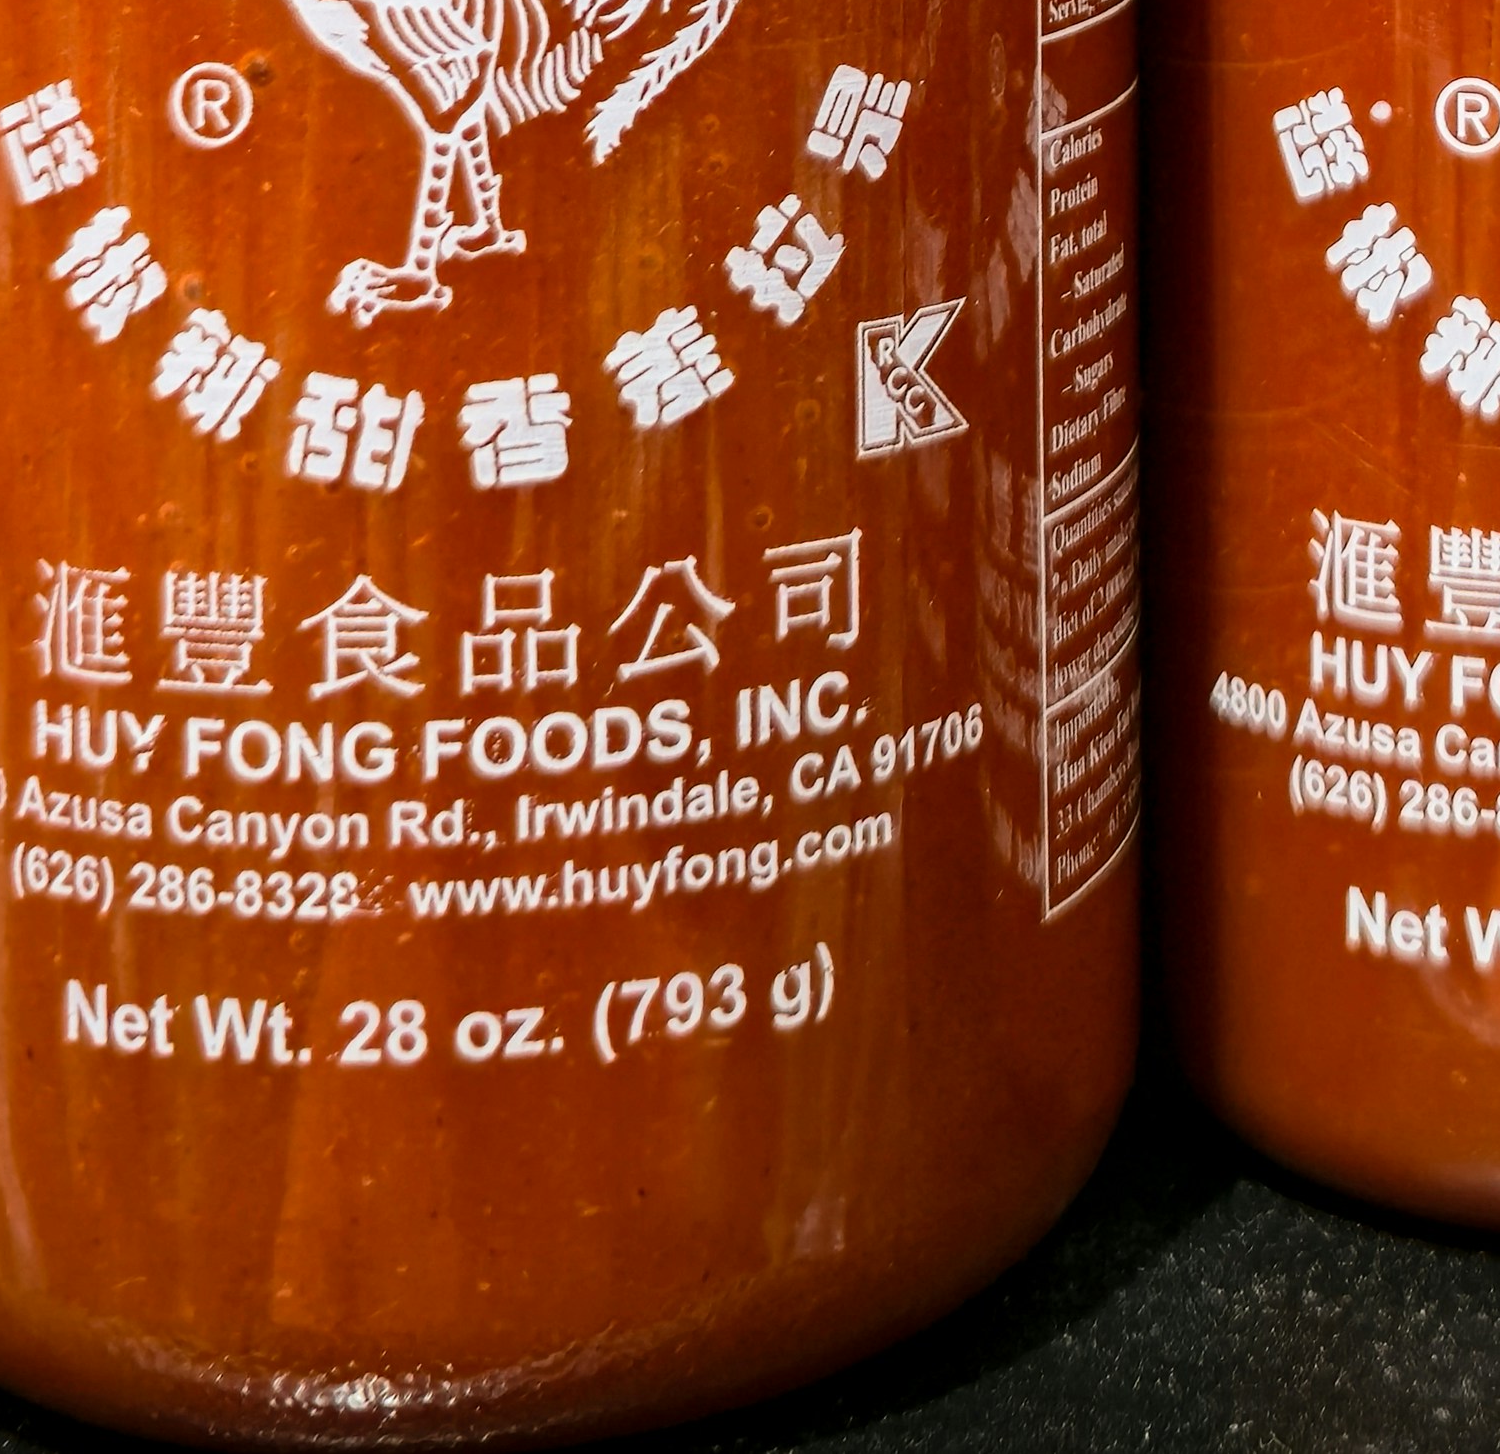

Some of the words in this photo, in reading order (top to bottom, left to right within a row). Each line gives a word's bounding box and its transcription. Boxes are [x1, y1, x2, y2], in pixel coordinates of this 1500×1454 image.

[1049, 125, 1103, 169] Calories
[1049, 173, 1098, 218] Protein
[1050, 451, 1102, 500] Sodium
[1309, 631, 1434, 711] HUY
[34, 699, 165, 773] HUY
[184, 717, 398, 782] FONG
[422, 699, 712, 782] FOODS,
[737, 671, 870, 750] INC.
[1209, 670, 1288, 739] 4800
[1293, 698, 1423, 763] Azusa
[15, 776, 153, 839] Azusa
[168, 796, 369, 860] Canyon
[516, 770, 775, 842] Irwindale,
[790, 746, 862, 803] CA
[871, 702, 985, 785] 91706
[1289, 754, 1388, 832] (626)
[11, 842, 115, 915] (626)
[127, 862, 359, 920] 286-8328
[409, 811, 895, 920] www.huyfong.com
[1344, 885, 1449, 962] Net
[65, 978, 175, 1057] Net
[194, 994, 312, 1065] Wt.
[338, 1001, 427, 1065] 28
[454, 1007, 565, 1061] oz.
[593, 963, 748, 1064] (793
[770, 941, 836, 1030] g)
